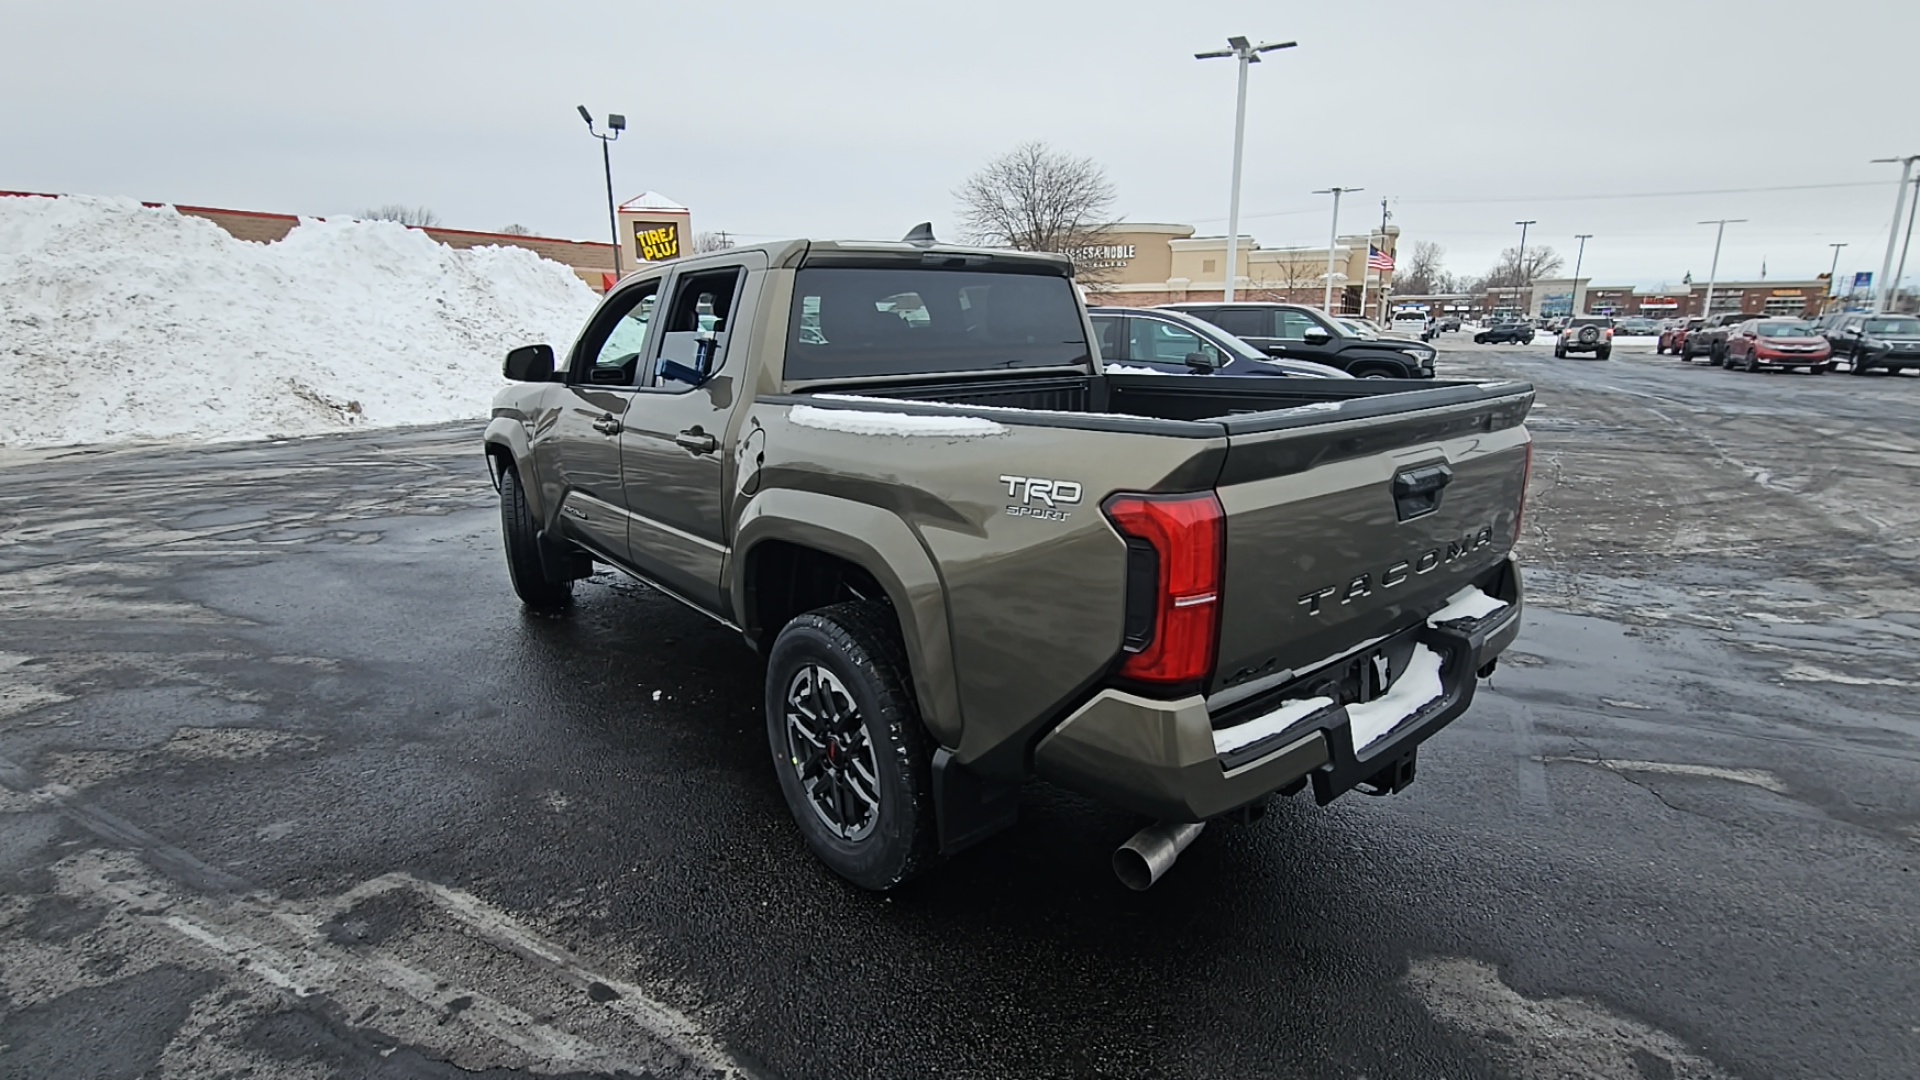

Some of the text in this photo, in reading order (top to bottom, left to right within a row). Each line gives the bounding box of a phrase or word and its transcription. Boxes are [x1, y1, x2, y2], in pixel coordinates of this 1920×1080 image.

[636, 226, 675, 247] TIRES
[643, 240, 677, 261] PLUS
[1000, 475, 1082, 507] TRD
[1006, 506, 1071, 522] SPORT
[1298, 525, 1493, 616] TACOMA
